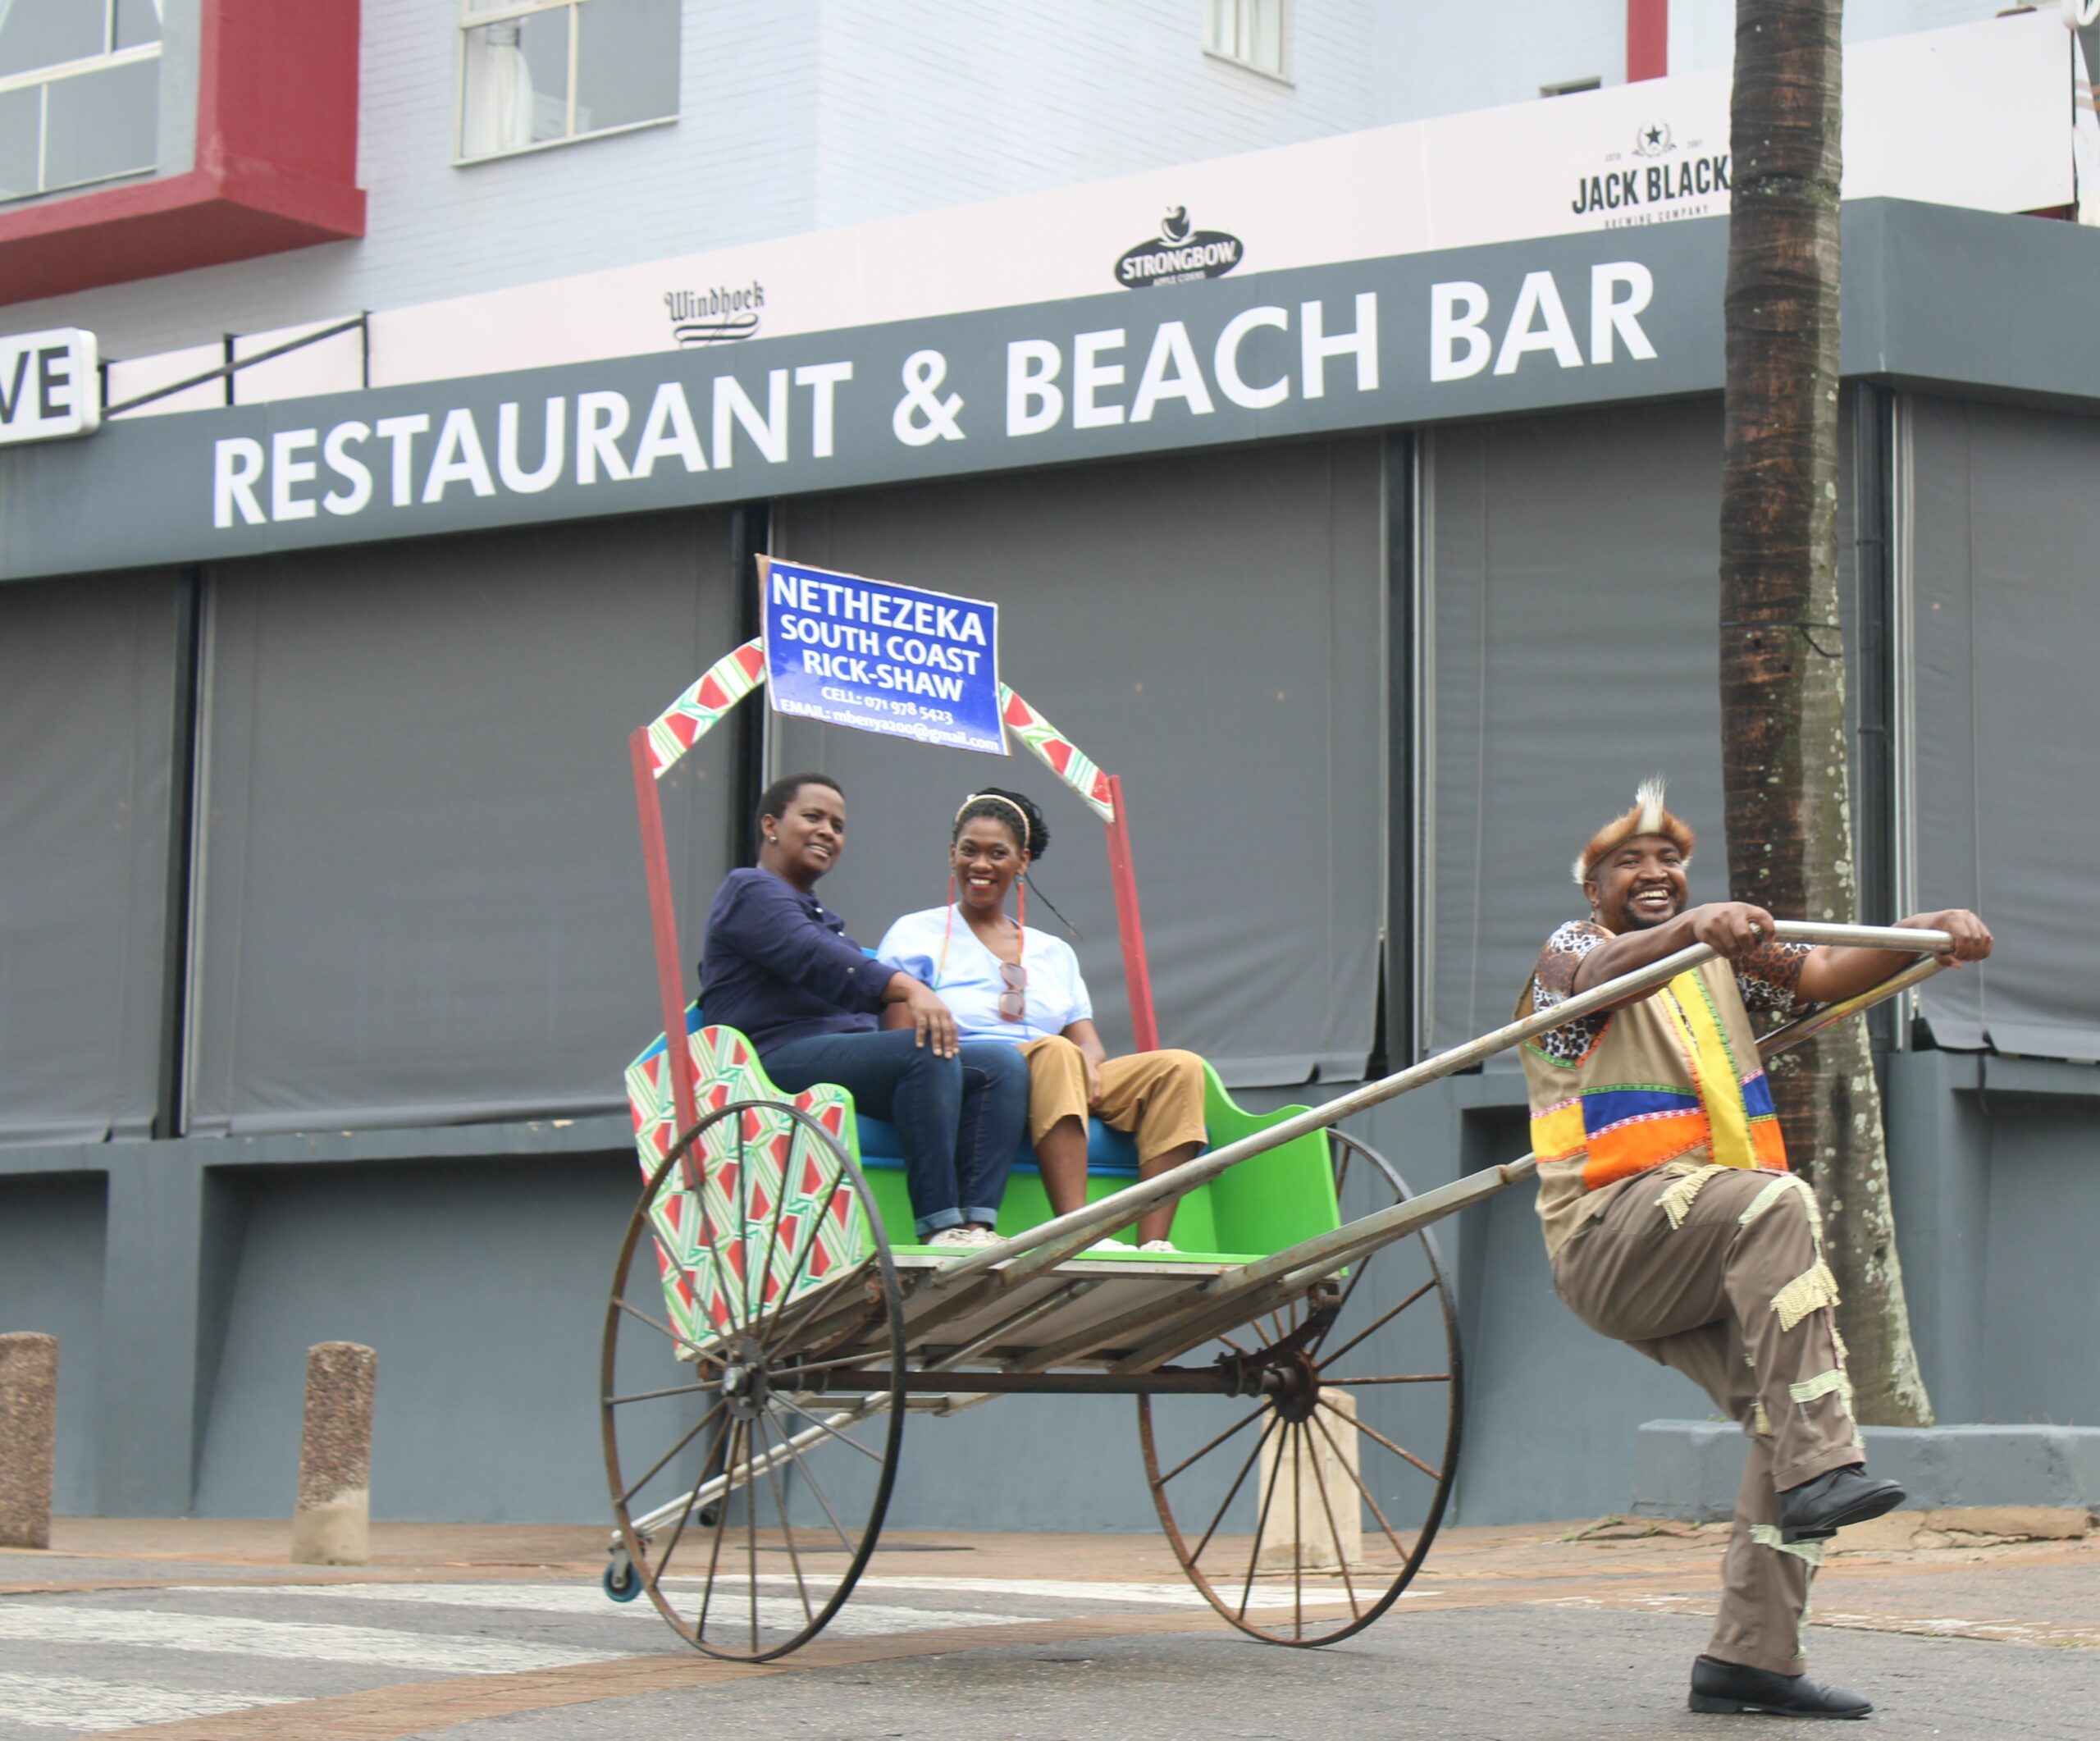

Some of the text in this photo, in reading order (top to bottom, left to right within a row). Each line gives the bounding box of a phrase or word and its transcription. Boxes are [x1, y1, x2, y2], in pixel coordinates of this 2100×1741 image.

[1572, 155, 1731, 214] JACK BLACK
[1659, 204, 1709, 222] COMPANY
[1121, 240, 1237, 281] STRONGBOW
[664, 280, 765, 322] Windhoek
[213, 260, 1659, 528] RESTAURANT & BEACH BAR
[772, 573, 987, 647] NETHEZEKA
[780, 614, 981, 675] SOUTH COAST
[802, 649, 964, 702] RICK-SHAW
[780, 698, 832, 720] EMAIL:
[821, 686, 954, 725] CELL: 071 978 5423
